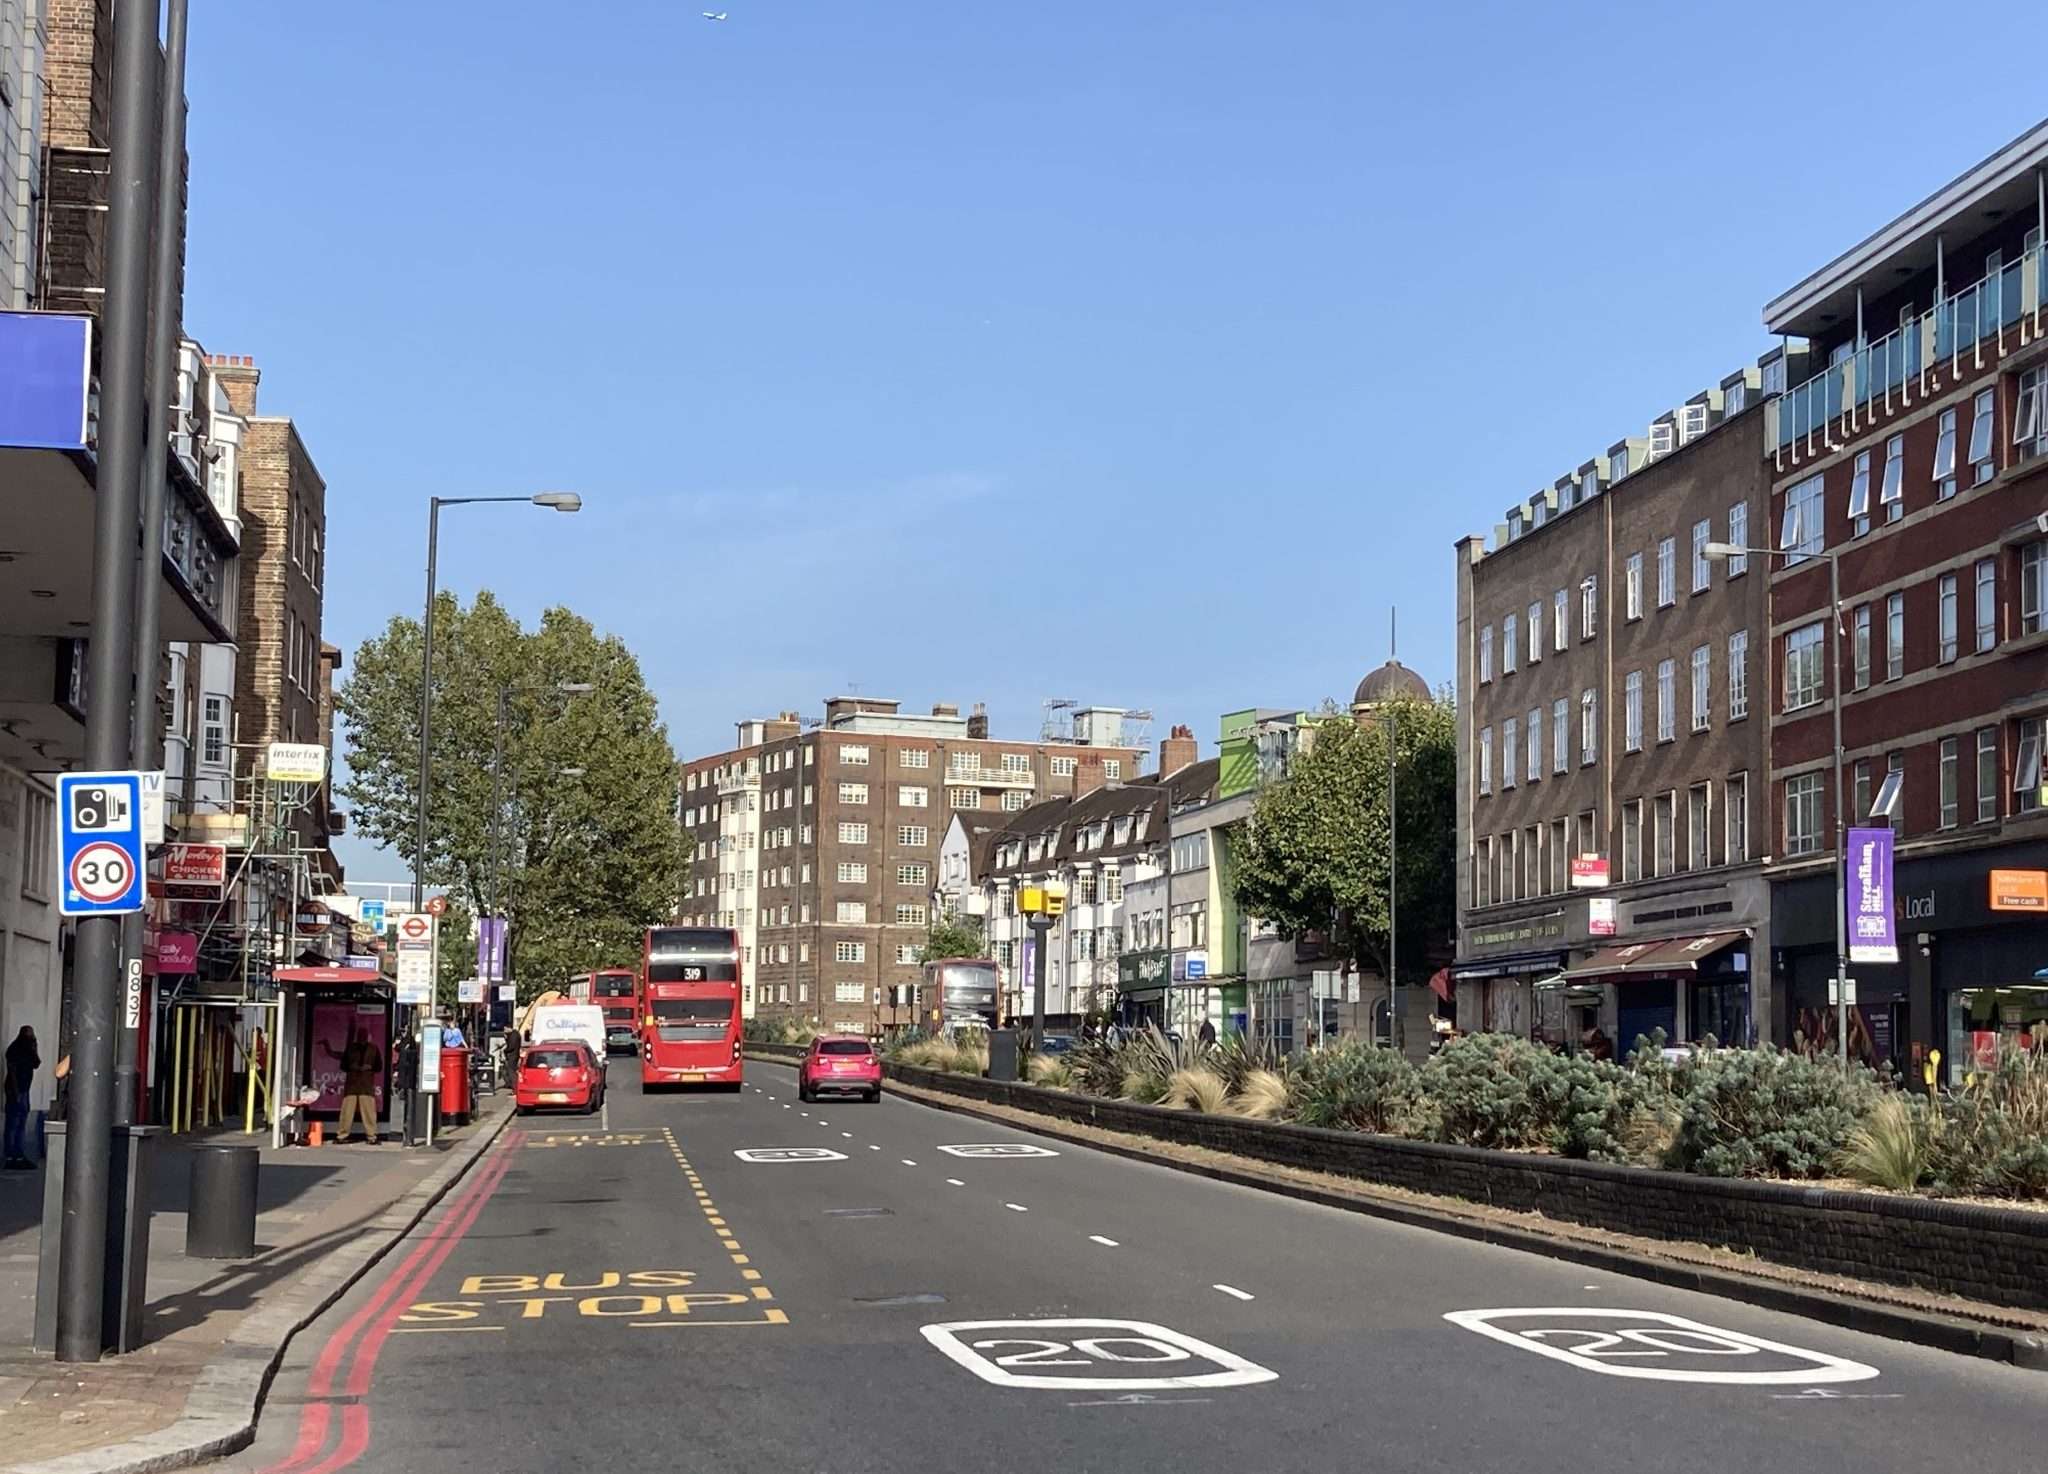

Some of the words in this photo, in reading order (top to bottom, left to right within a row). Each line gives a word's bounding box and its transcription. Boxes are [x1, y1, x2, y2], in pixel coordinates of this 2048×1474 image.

[273, 749, 320, 759] interfix
[81, 860, 124, 885] 30
[170, 866, 221, 874] CHICKEN
[1574, 862, 1593, 870] KFH
[165, 884, 220, 898] OPEN
[432, 900, 441, 912] S
[1906, 889, 1935, 919] Local
[684, 967, 701, 980] 319
[129, 961, 142, 1027] 0837
[459, 1270, 697, 1294] BUS
[400, 1293, 749, 1321] STOP
[973, 1338, 1191, 1365] 20
[1520, 1328, 1760, 1357] 20
